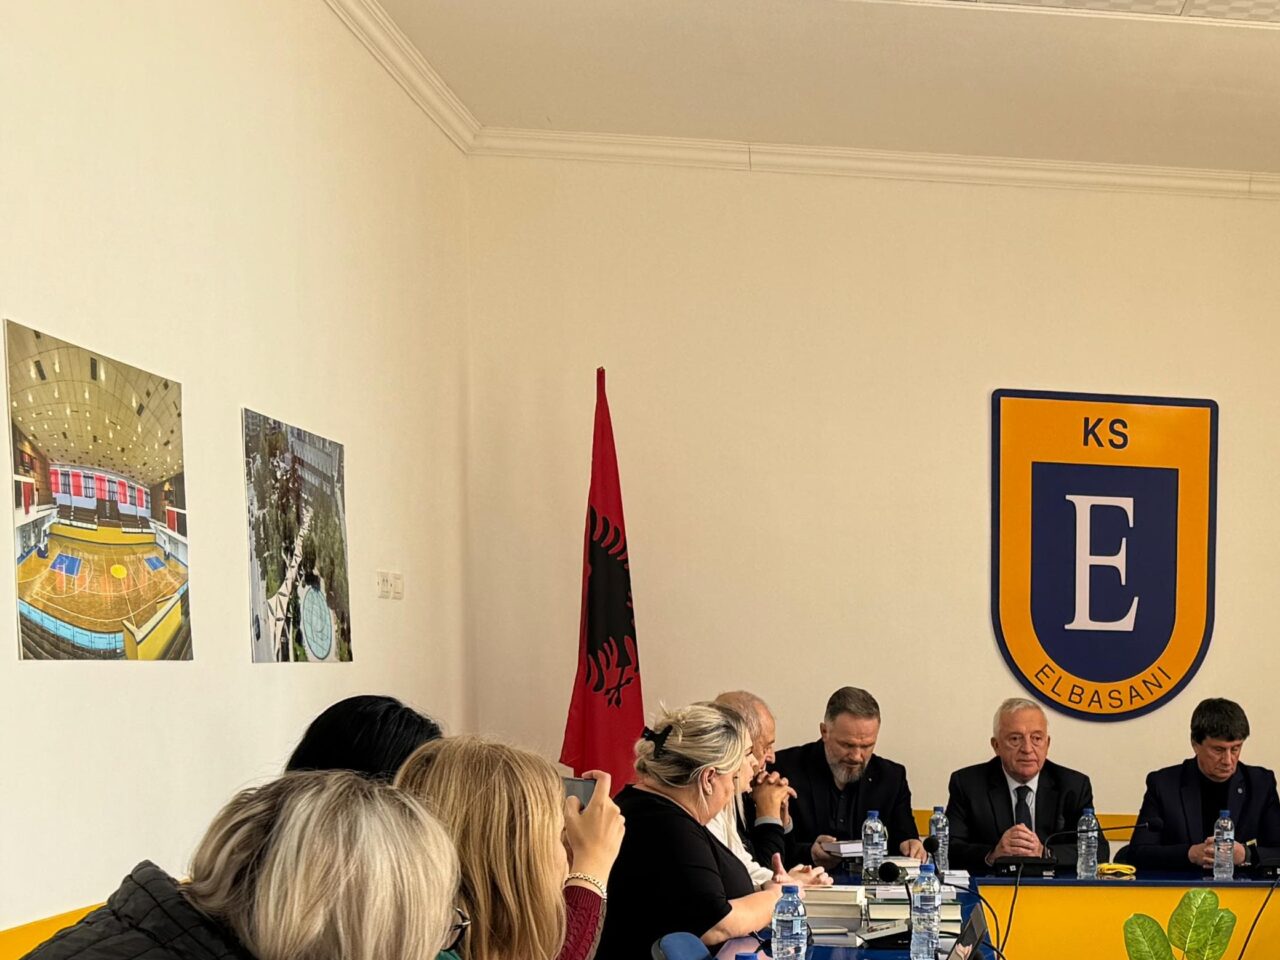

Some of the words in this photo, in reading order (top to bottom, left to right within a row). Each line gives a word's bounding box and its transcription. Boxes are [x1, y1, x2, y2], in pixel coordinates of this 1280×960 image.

[1083, 416, 1129, 450] KS
[1064, 494, 1140, 632] E
[1033, 663, 1172, 710] ELBASANI
